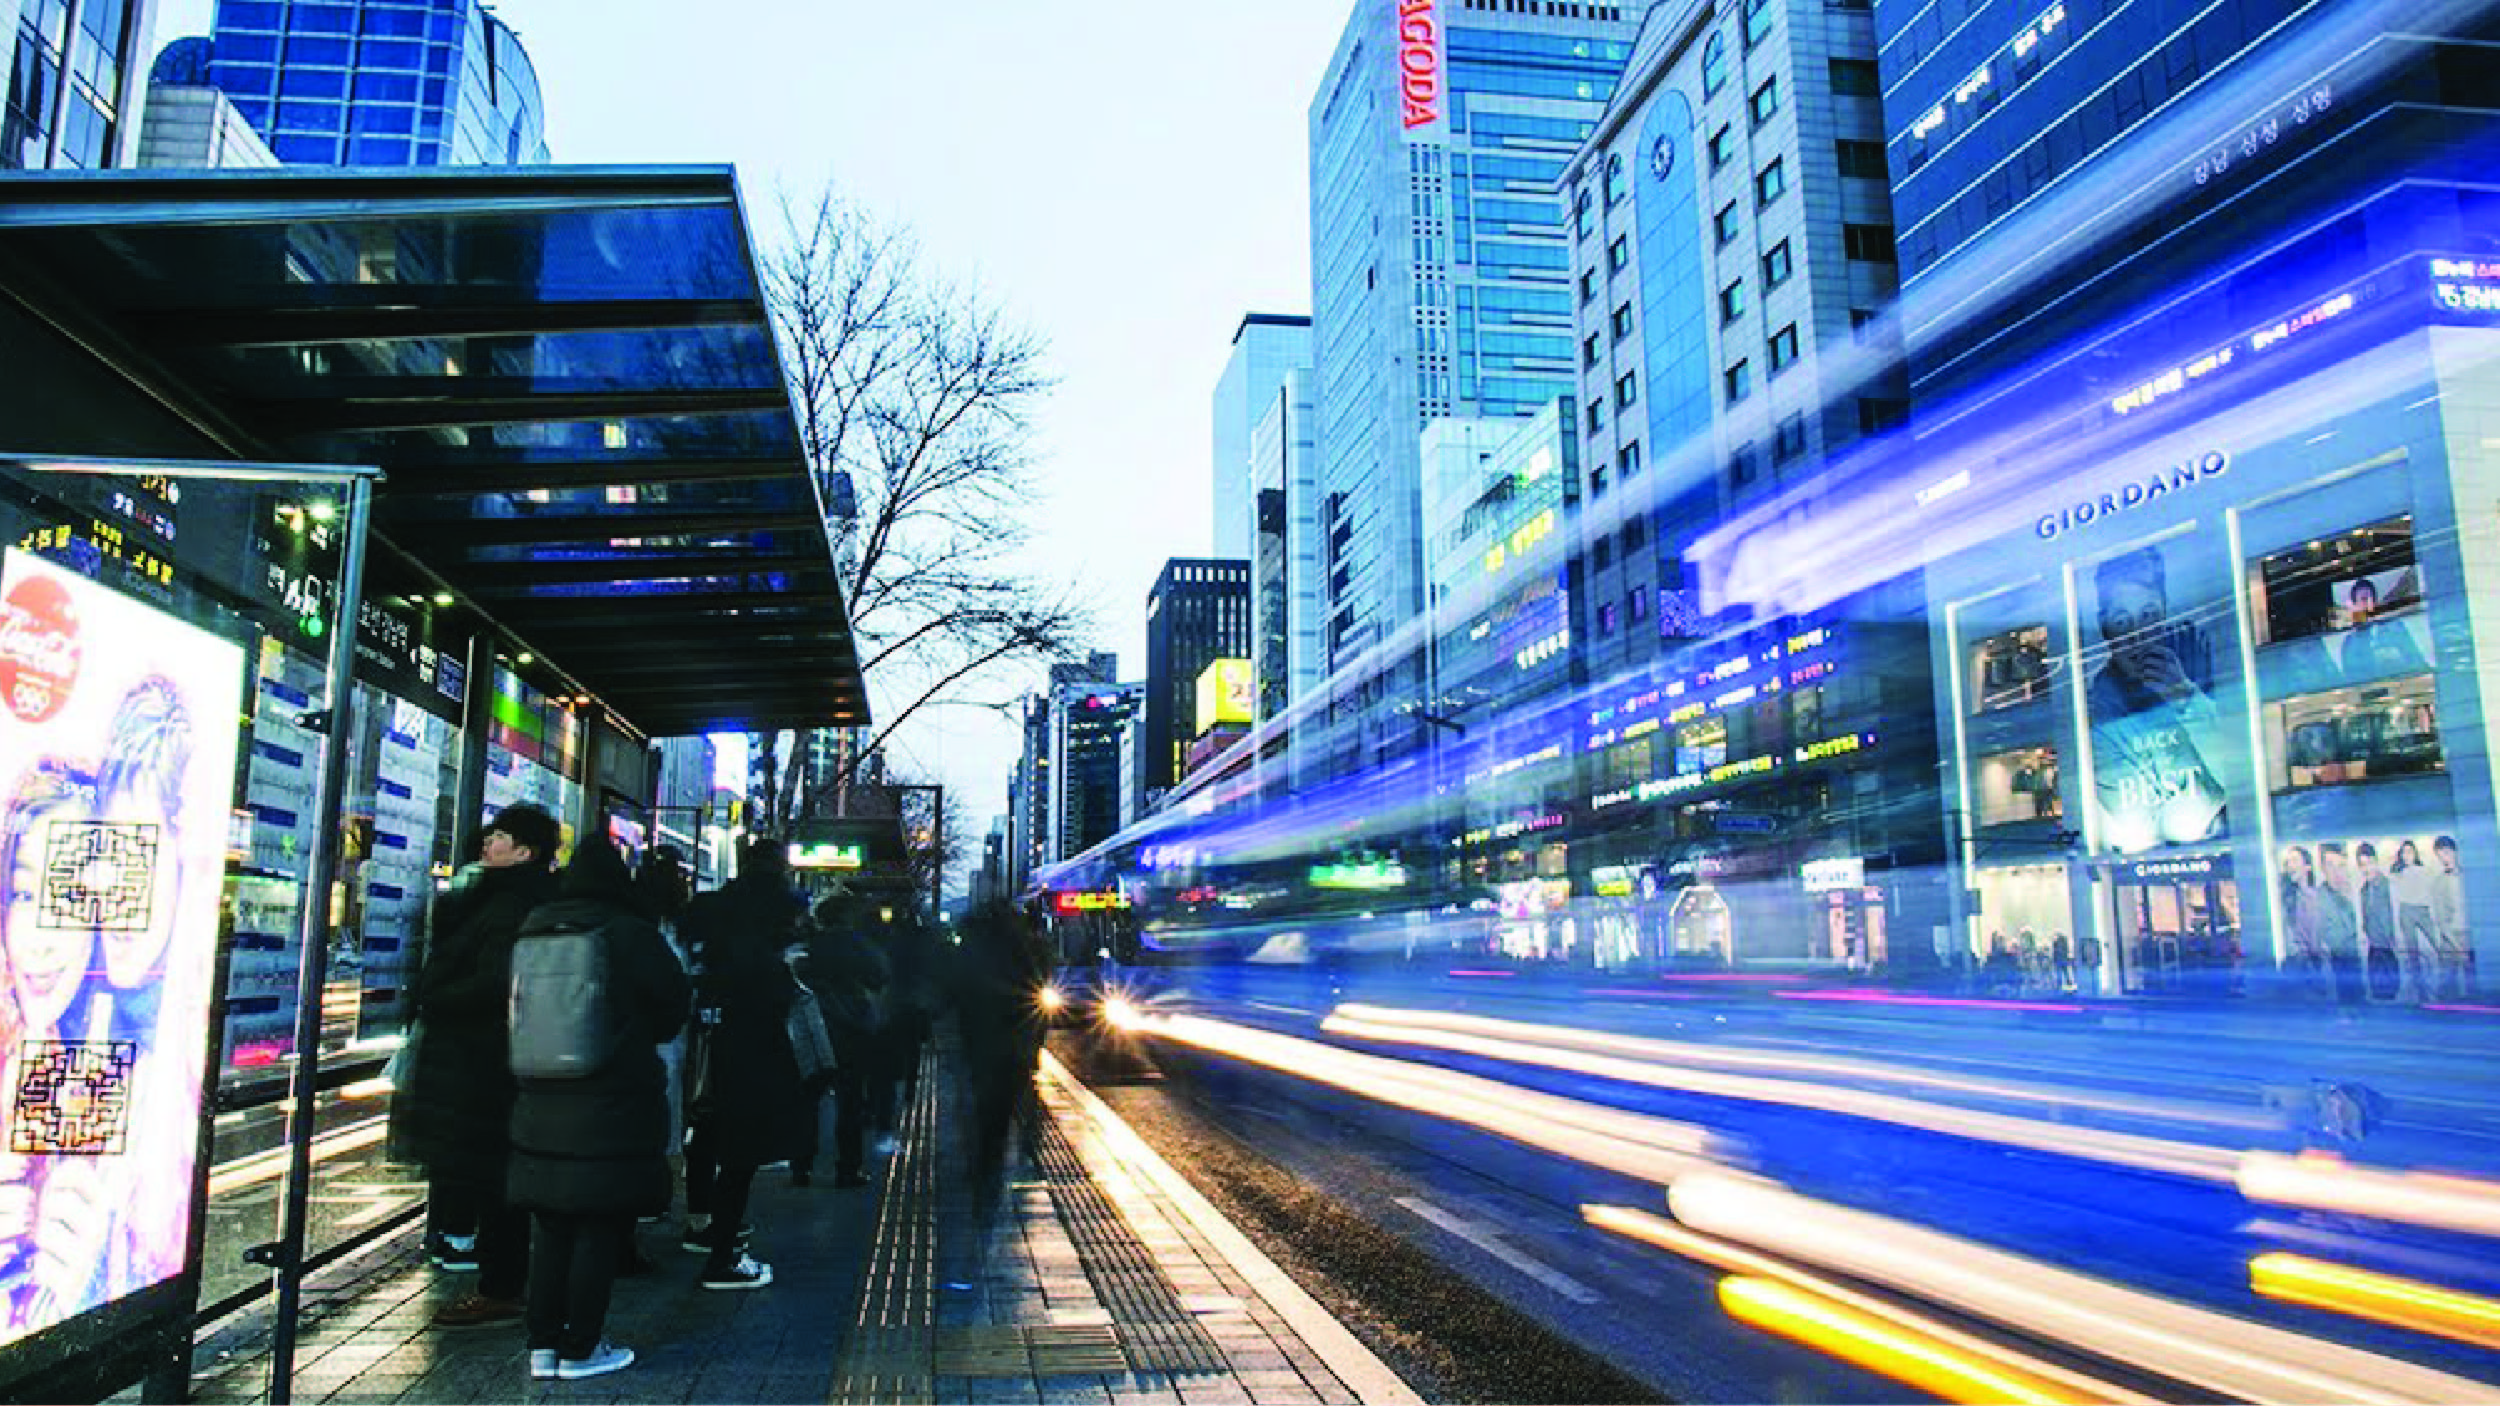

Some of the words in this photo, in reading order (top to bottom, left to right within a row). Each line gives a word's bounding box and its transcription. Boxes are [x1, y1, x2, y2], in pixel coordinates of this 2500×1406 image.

[2036, 451, 2228, 540] GIORDANO
[2133, 729, 2180, 752] BACK
[2137, 860, 2212, 877] GIORDANO
